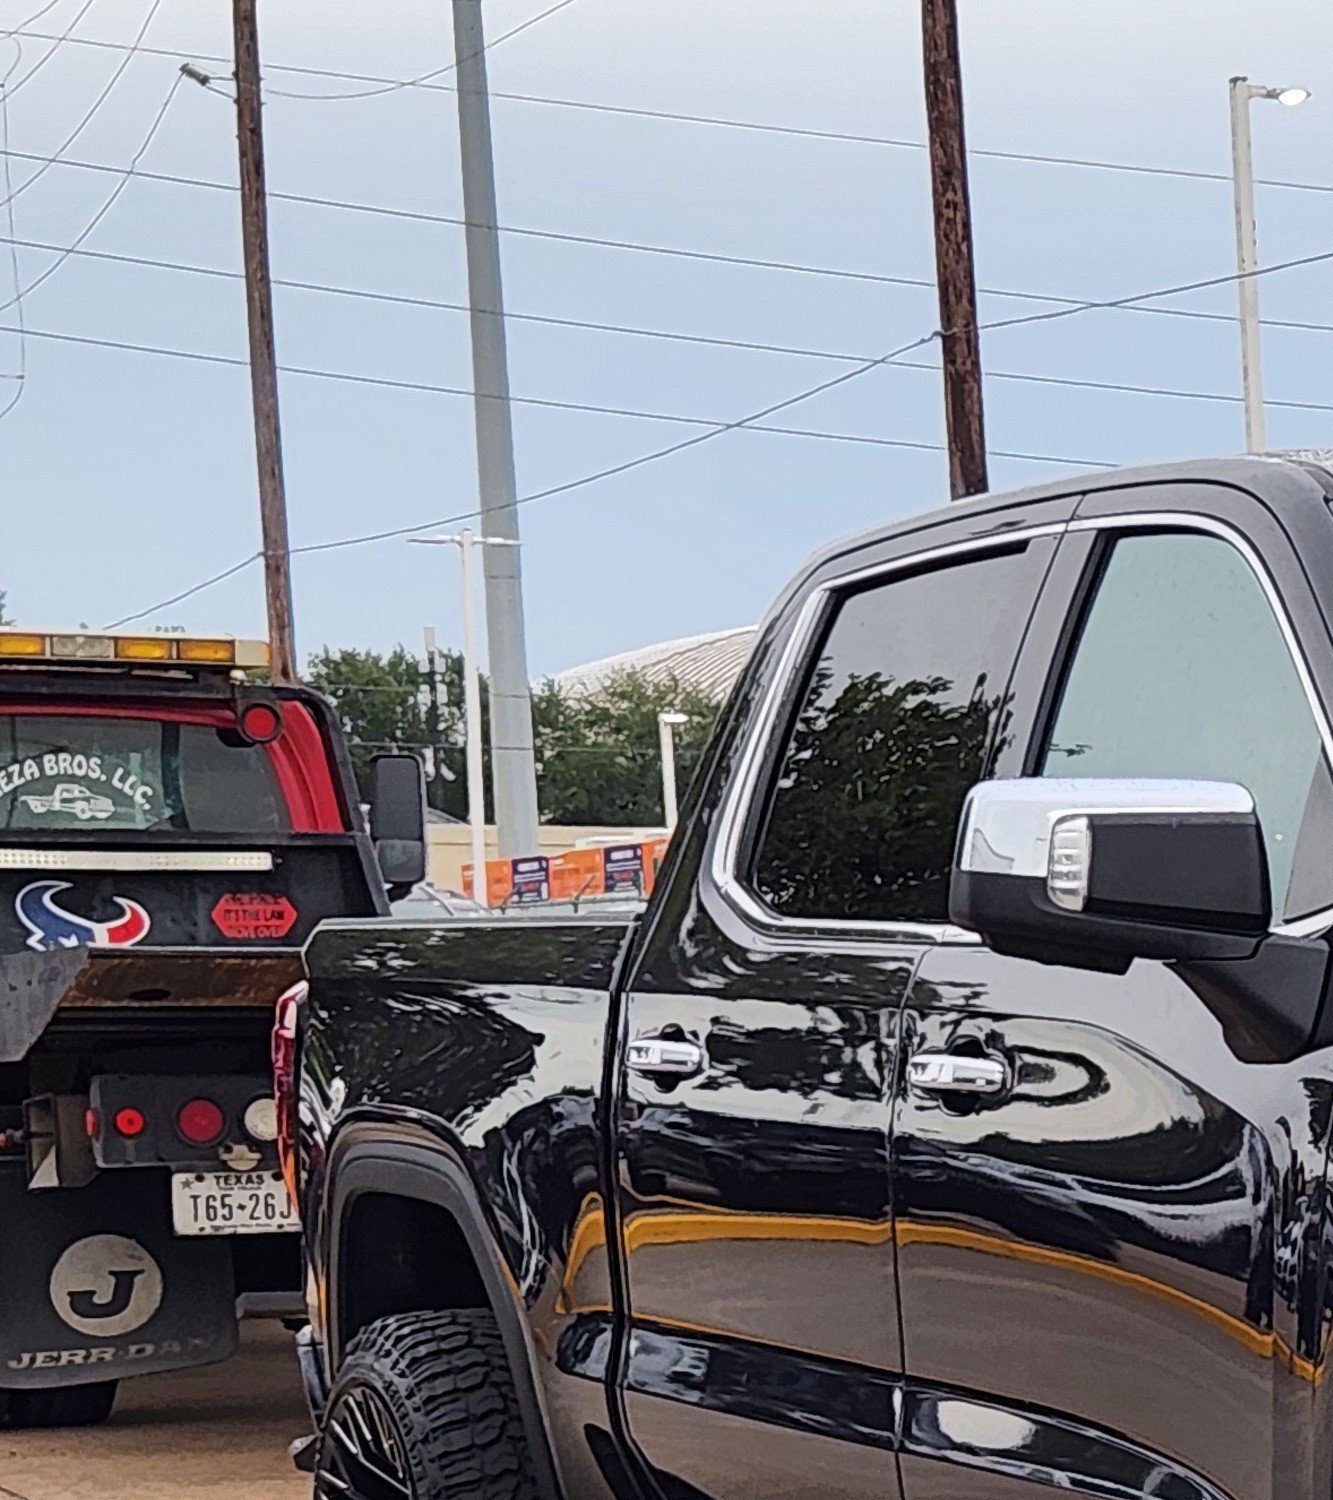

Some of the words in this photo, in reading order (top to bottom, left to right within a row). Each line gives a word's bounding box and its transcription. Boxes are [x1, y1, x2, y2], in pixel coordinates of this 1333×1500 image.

[0, 758, 40, 799] EZA
[43, 752, 107, 782] BROS.
[111, 767, 153, 810] LLC.
[213, 1174, 265, 1186] TEXAS
[189, 1193, 233, 1222] T65
[67, 1269, 146, 1319] J
